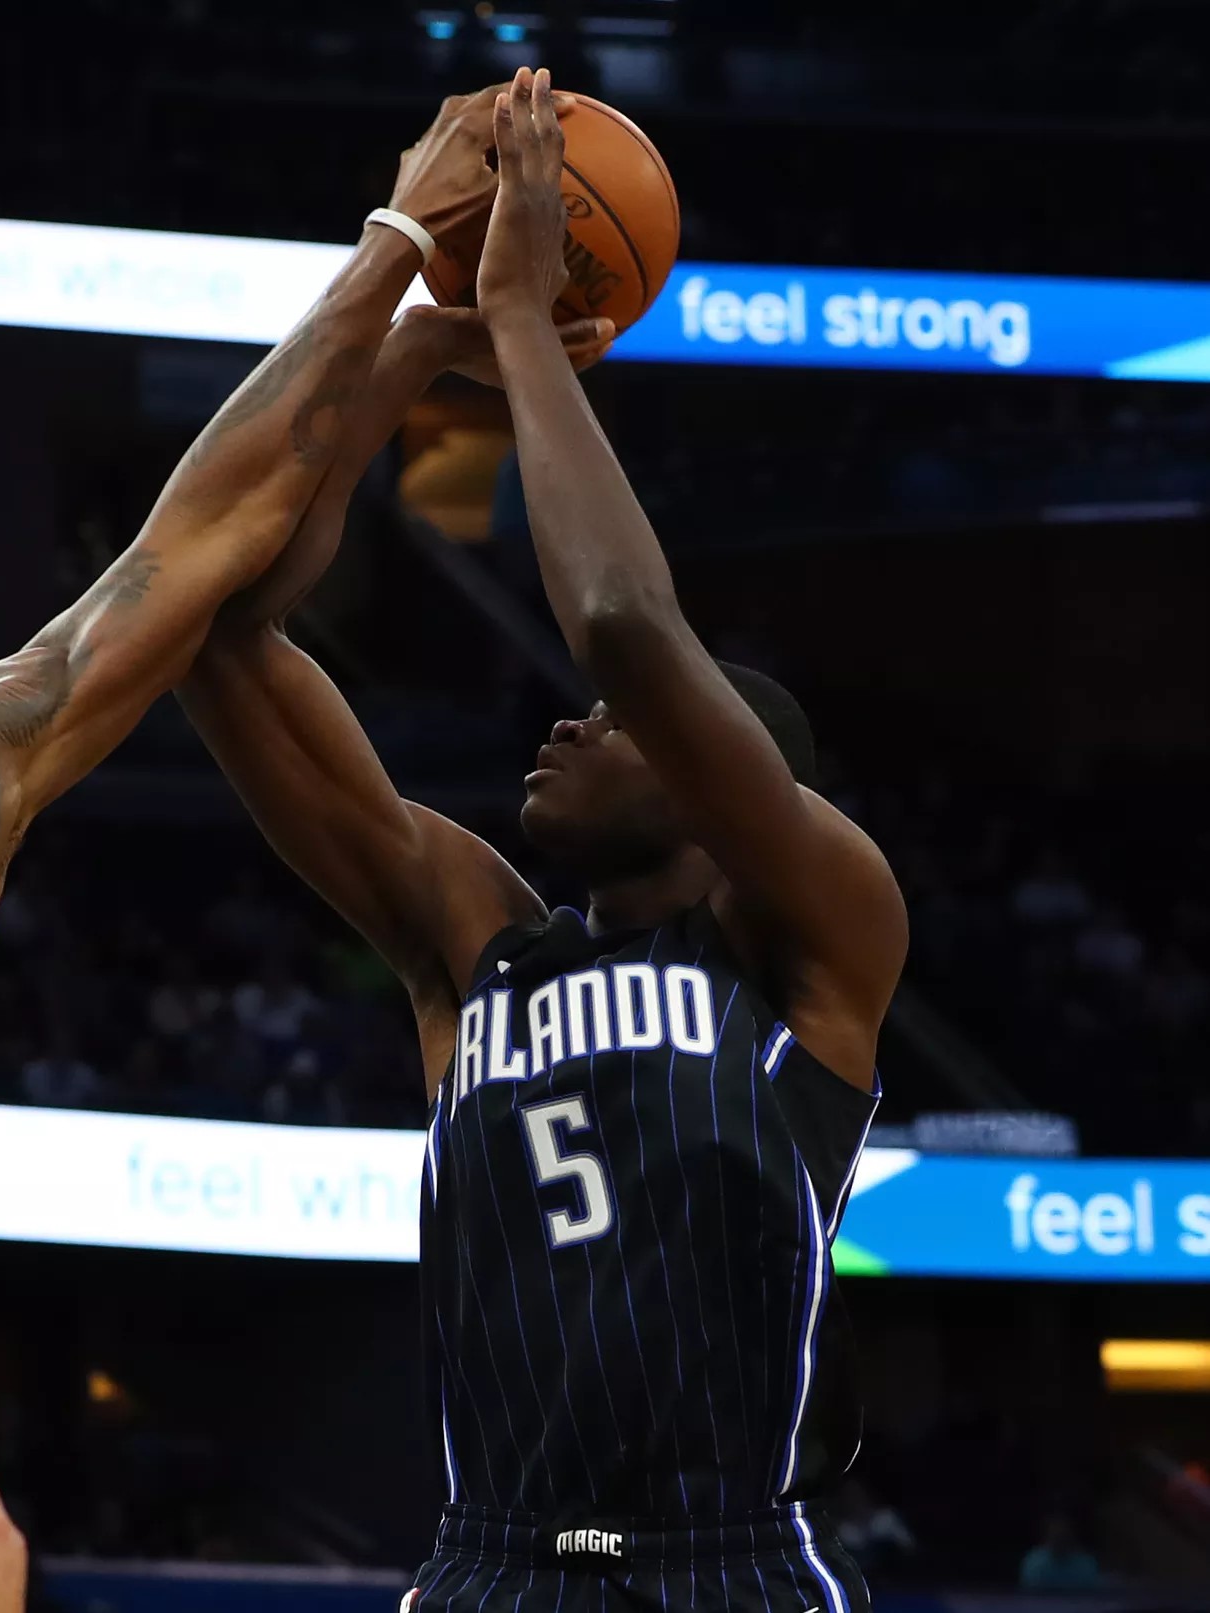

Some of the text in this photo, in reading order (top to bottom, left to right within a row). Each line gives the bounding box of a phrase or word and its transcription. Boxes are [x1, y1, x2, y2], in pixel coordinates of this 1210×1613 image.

[679, 276, 1030, 367] feel strong
[457, 962, 718, 1102] RLANDO
[127, 1141, 264, 1219] feel
[518, 1092, 616, 1249] 5
[1004, 1172, 1155, 1256] feel
[556, 1528, 623, 1557] MAGIC
